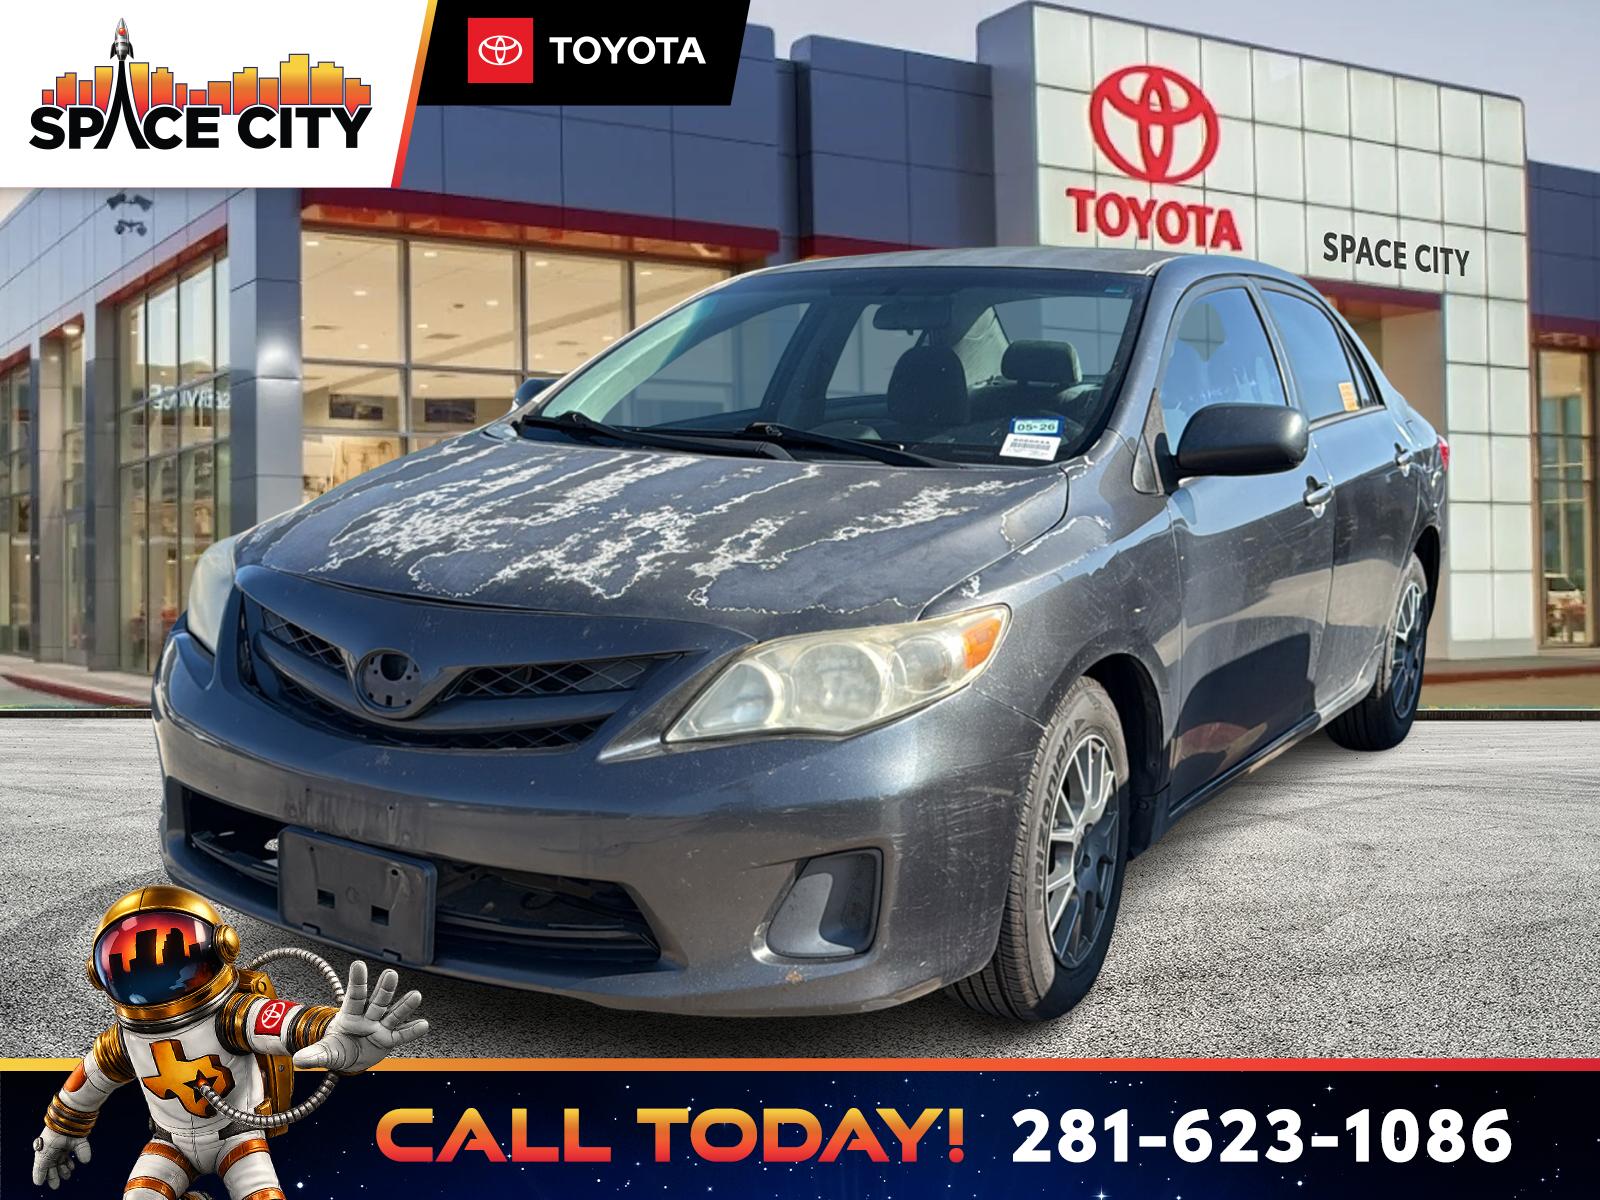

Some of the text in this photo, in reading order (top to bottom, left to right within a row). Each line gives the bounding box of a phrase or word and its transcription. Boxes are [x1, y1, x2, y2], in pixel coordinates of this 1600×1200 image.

[1065, 187, 1243, 252] TOYOTA
[1323, 231, 1470, 277] SPACE CITY
[1016, 423, 1056, 431] 05-26
